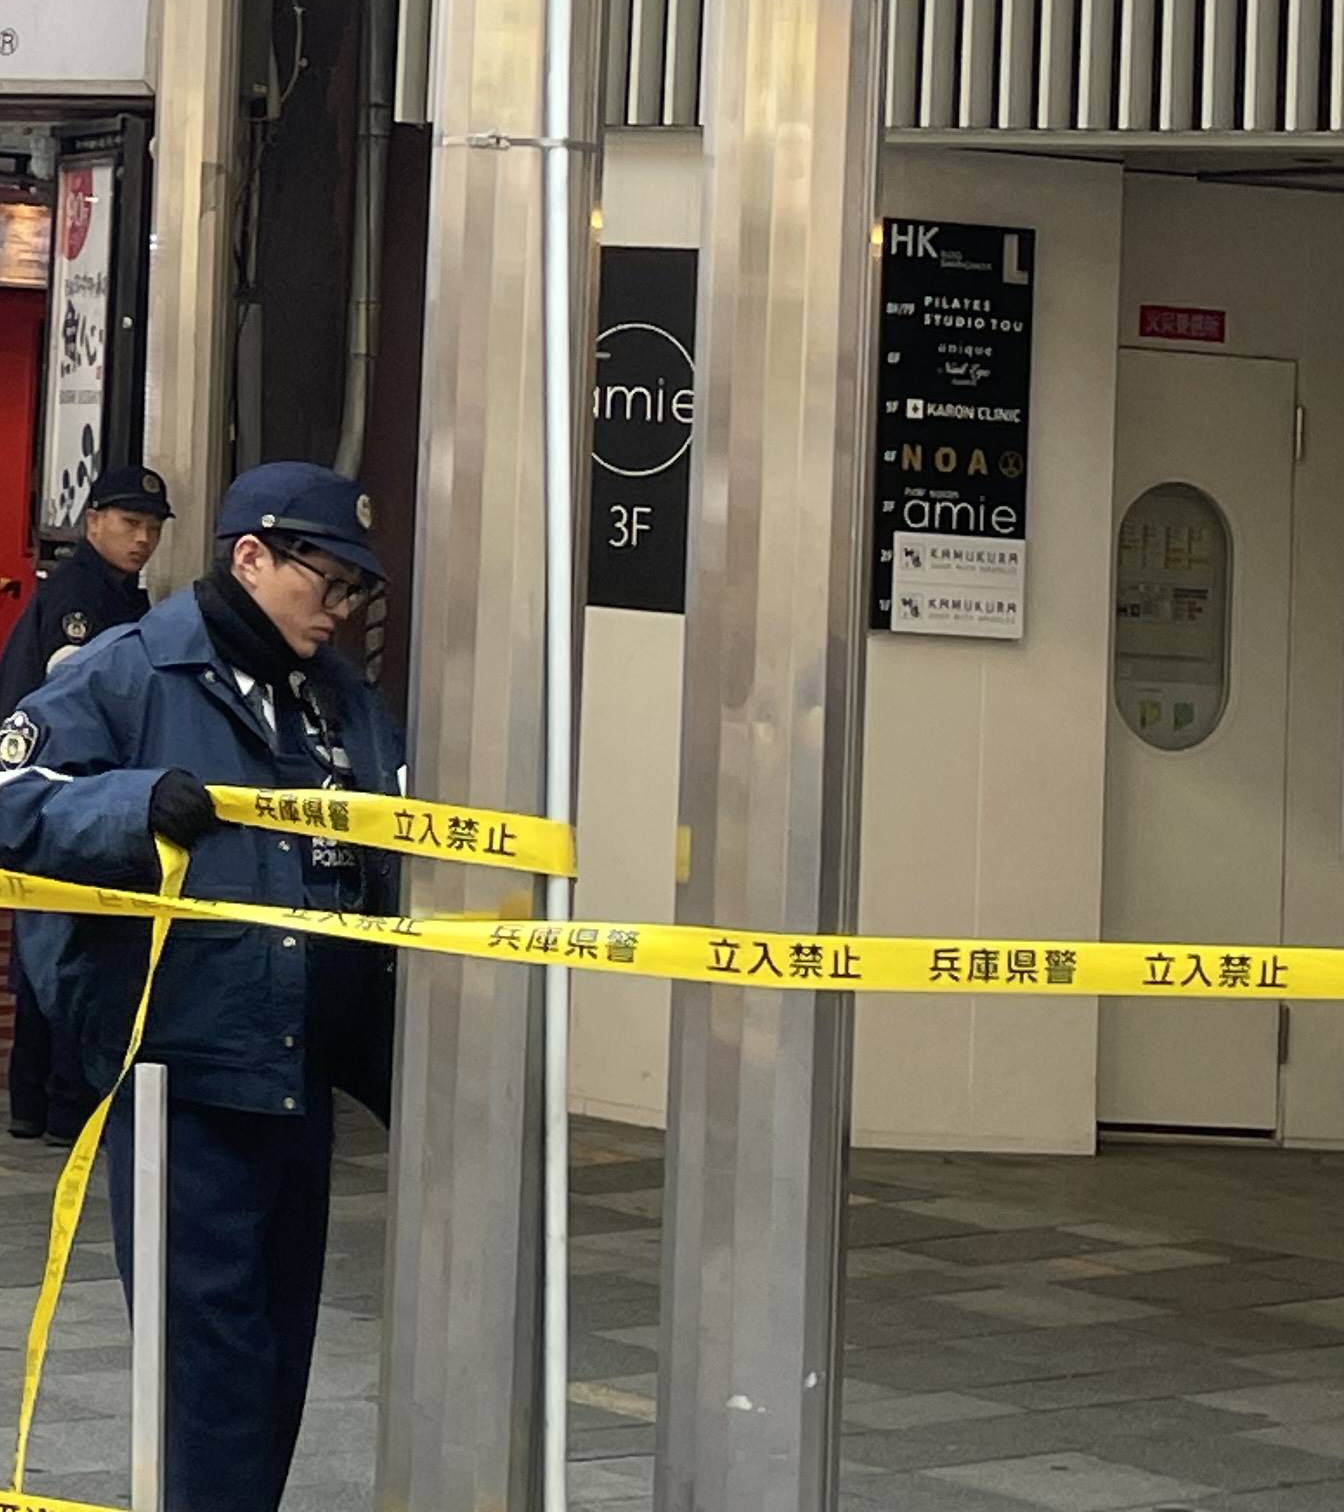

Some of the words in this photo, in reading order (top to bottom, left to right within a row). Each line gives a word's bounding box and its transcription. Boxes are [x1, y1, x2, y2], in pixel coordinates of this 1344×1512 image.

[890, 223, 940, 258] HK
[924, 295, 992, 312] PILATES
[923, 313, 986, 330] STUDIO
[591, 378, 695, 424] mie
[977, 407, 1021, 424] CLINIC
[901, 443, 989, 476] NOA
[609, 504, 653, 548] 3F
[904, 495, 1017, 534] amie
[930, 548, 1019, 565] KAMUKURA
[928, 598, 1017, 614] KAMUKURA
[254, 789, 350, 833] 兵庫県警
[393, 807, 518, 857] 立入禁止
[488, 923, 641, 964] 兵庫県警
[707, 937, 862, 981] 立入禁止
[929, 947, 1078, 986] 兵庫県警
[1143, 954, 1289, 990] 立入禁止
